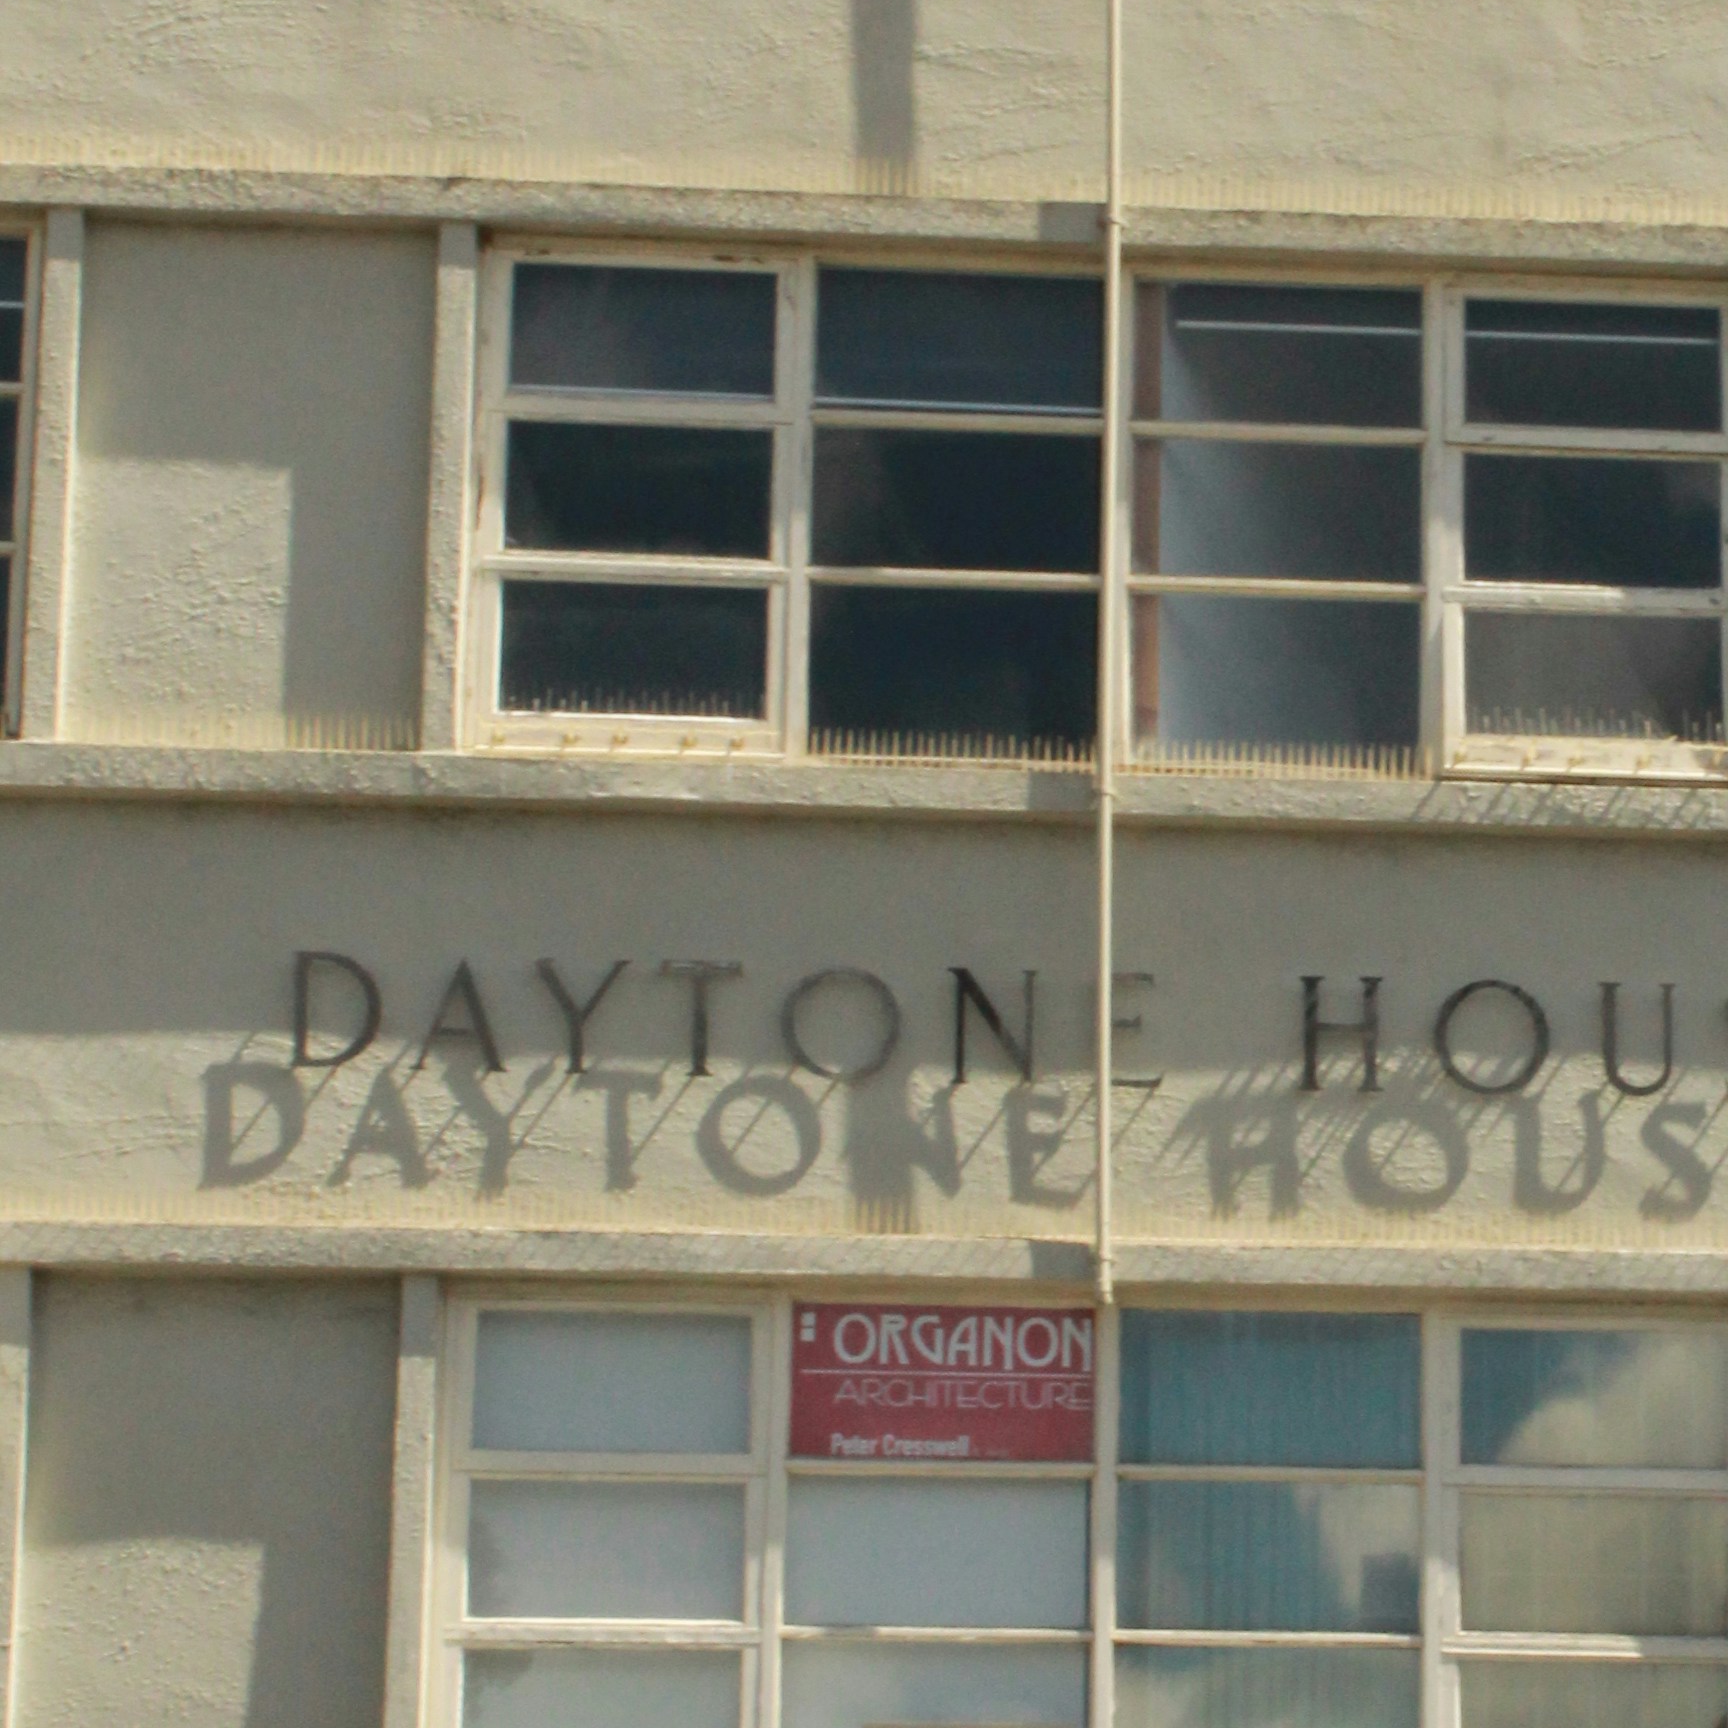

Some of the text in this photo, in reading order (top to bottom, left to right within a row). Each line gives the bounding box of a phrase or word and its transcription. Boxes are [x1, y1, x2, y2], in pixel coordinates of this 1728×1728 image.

[291, 950, 1163, 1089] DAYTONE
[834, 1312, 1092, 1371] ORGANON
[833, 1377, 1091, 1410] ARCHITECTURE
[831, 1432, 877, 1456] Peter
[882, 1432, 970, 1457] Cresswell
